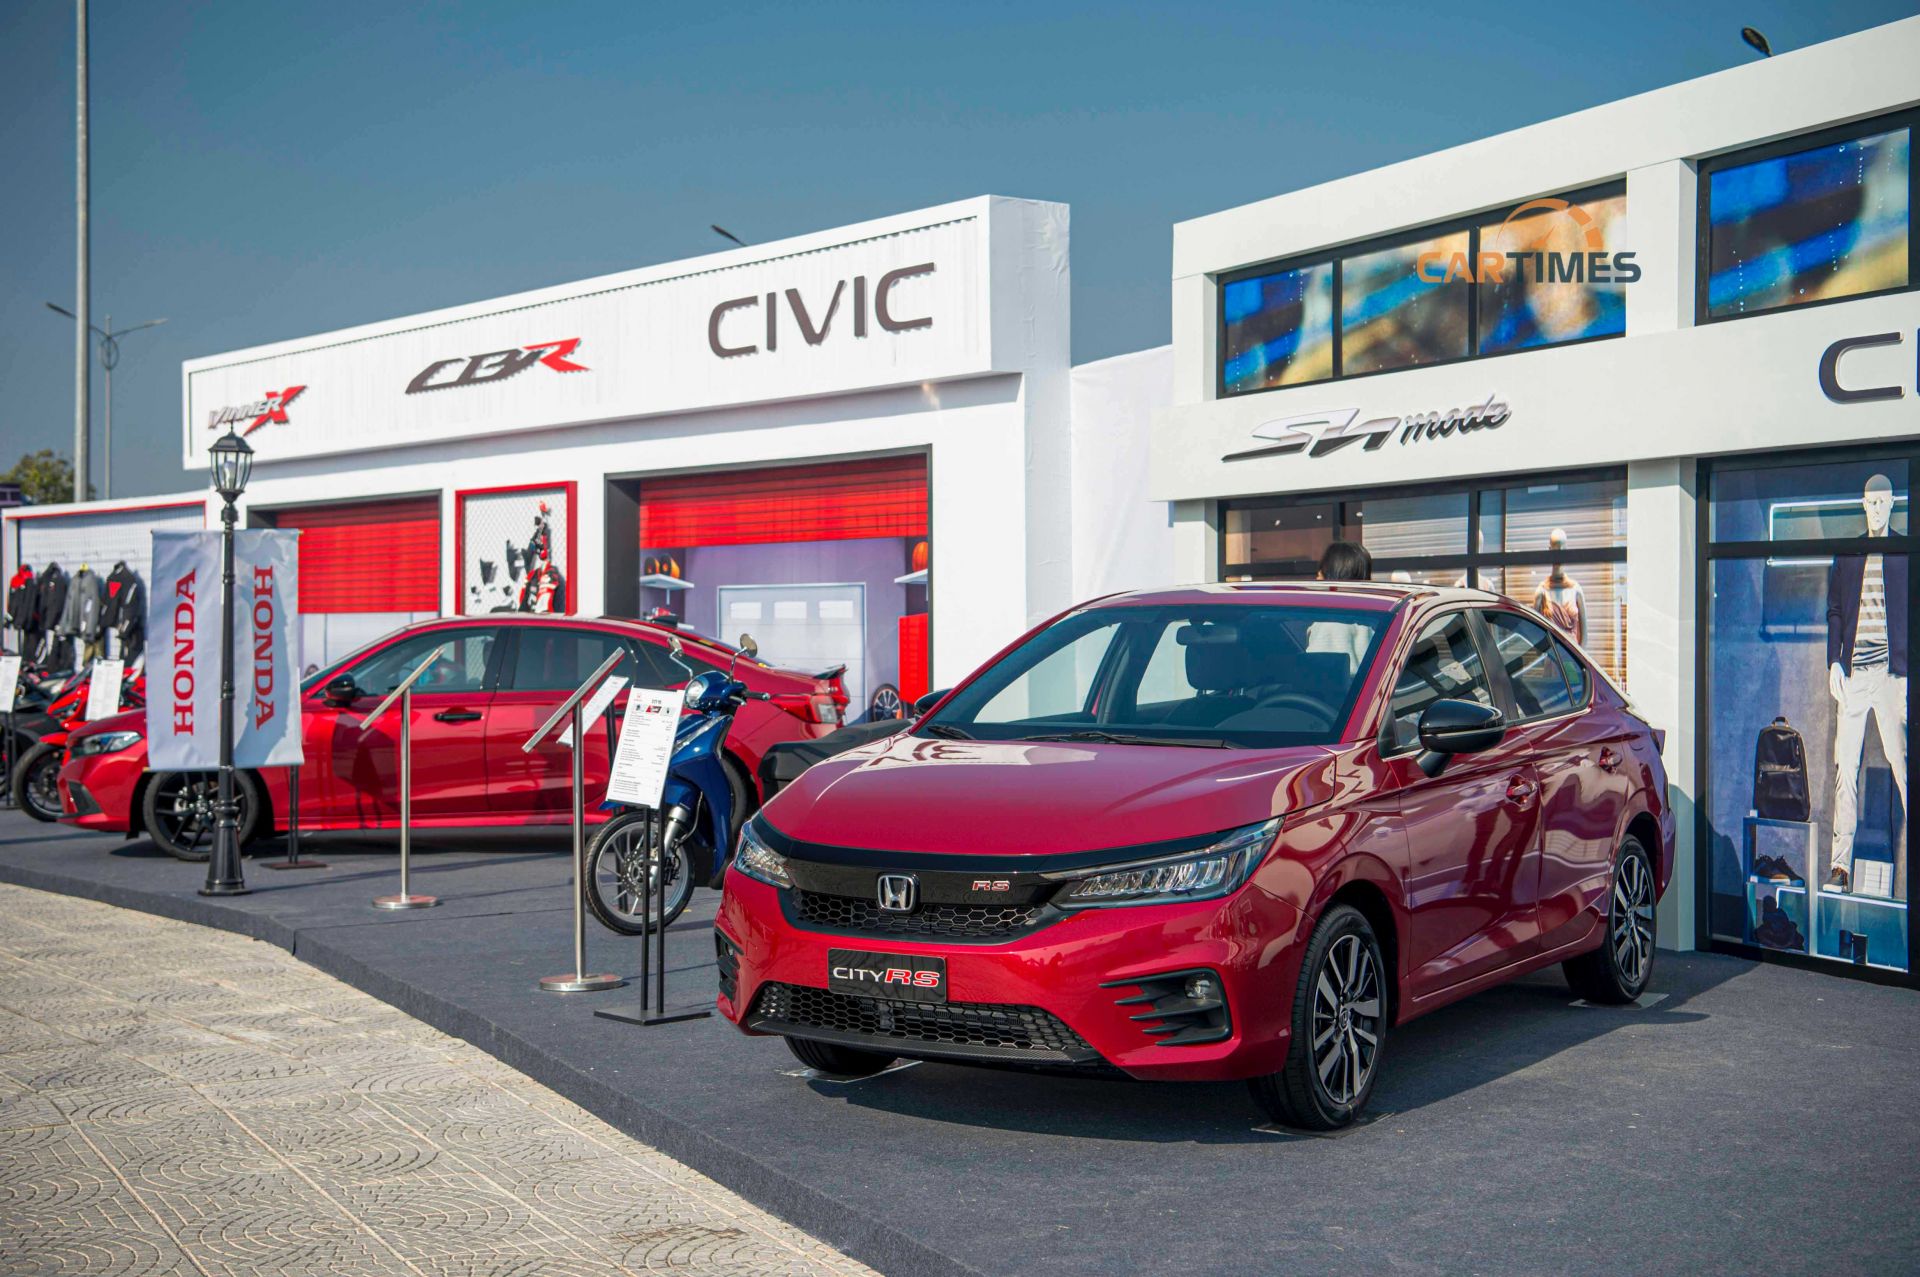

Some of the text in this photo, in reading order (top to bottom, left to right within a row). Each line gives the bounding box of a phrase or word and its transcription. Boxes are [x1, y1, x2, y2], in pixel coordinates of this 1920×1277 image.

[708, 262, 936, 359] CIVIC
[405, 337, 591, 395] CBR
[1818, 326, 1920, 405] C
[1400, 392, 1512, 446] mode
[172, 567, 197, 737] HONDA
[253, 565, 275, 731] HONDA
[971, 880, 1010, 892] RS
